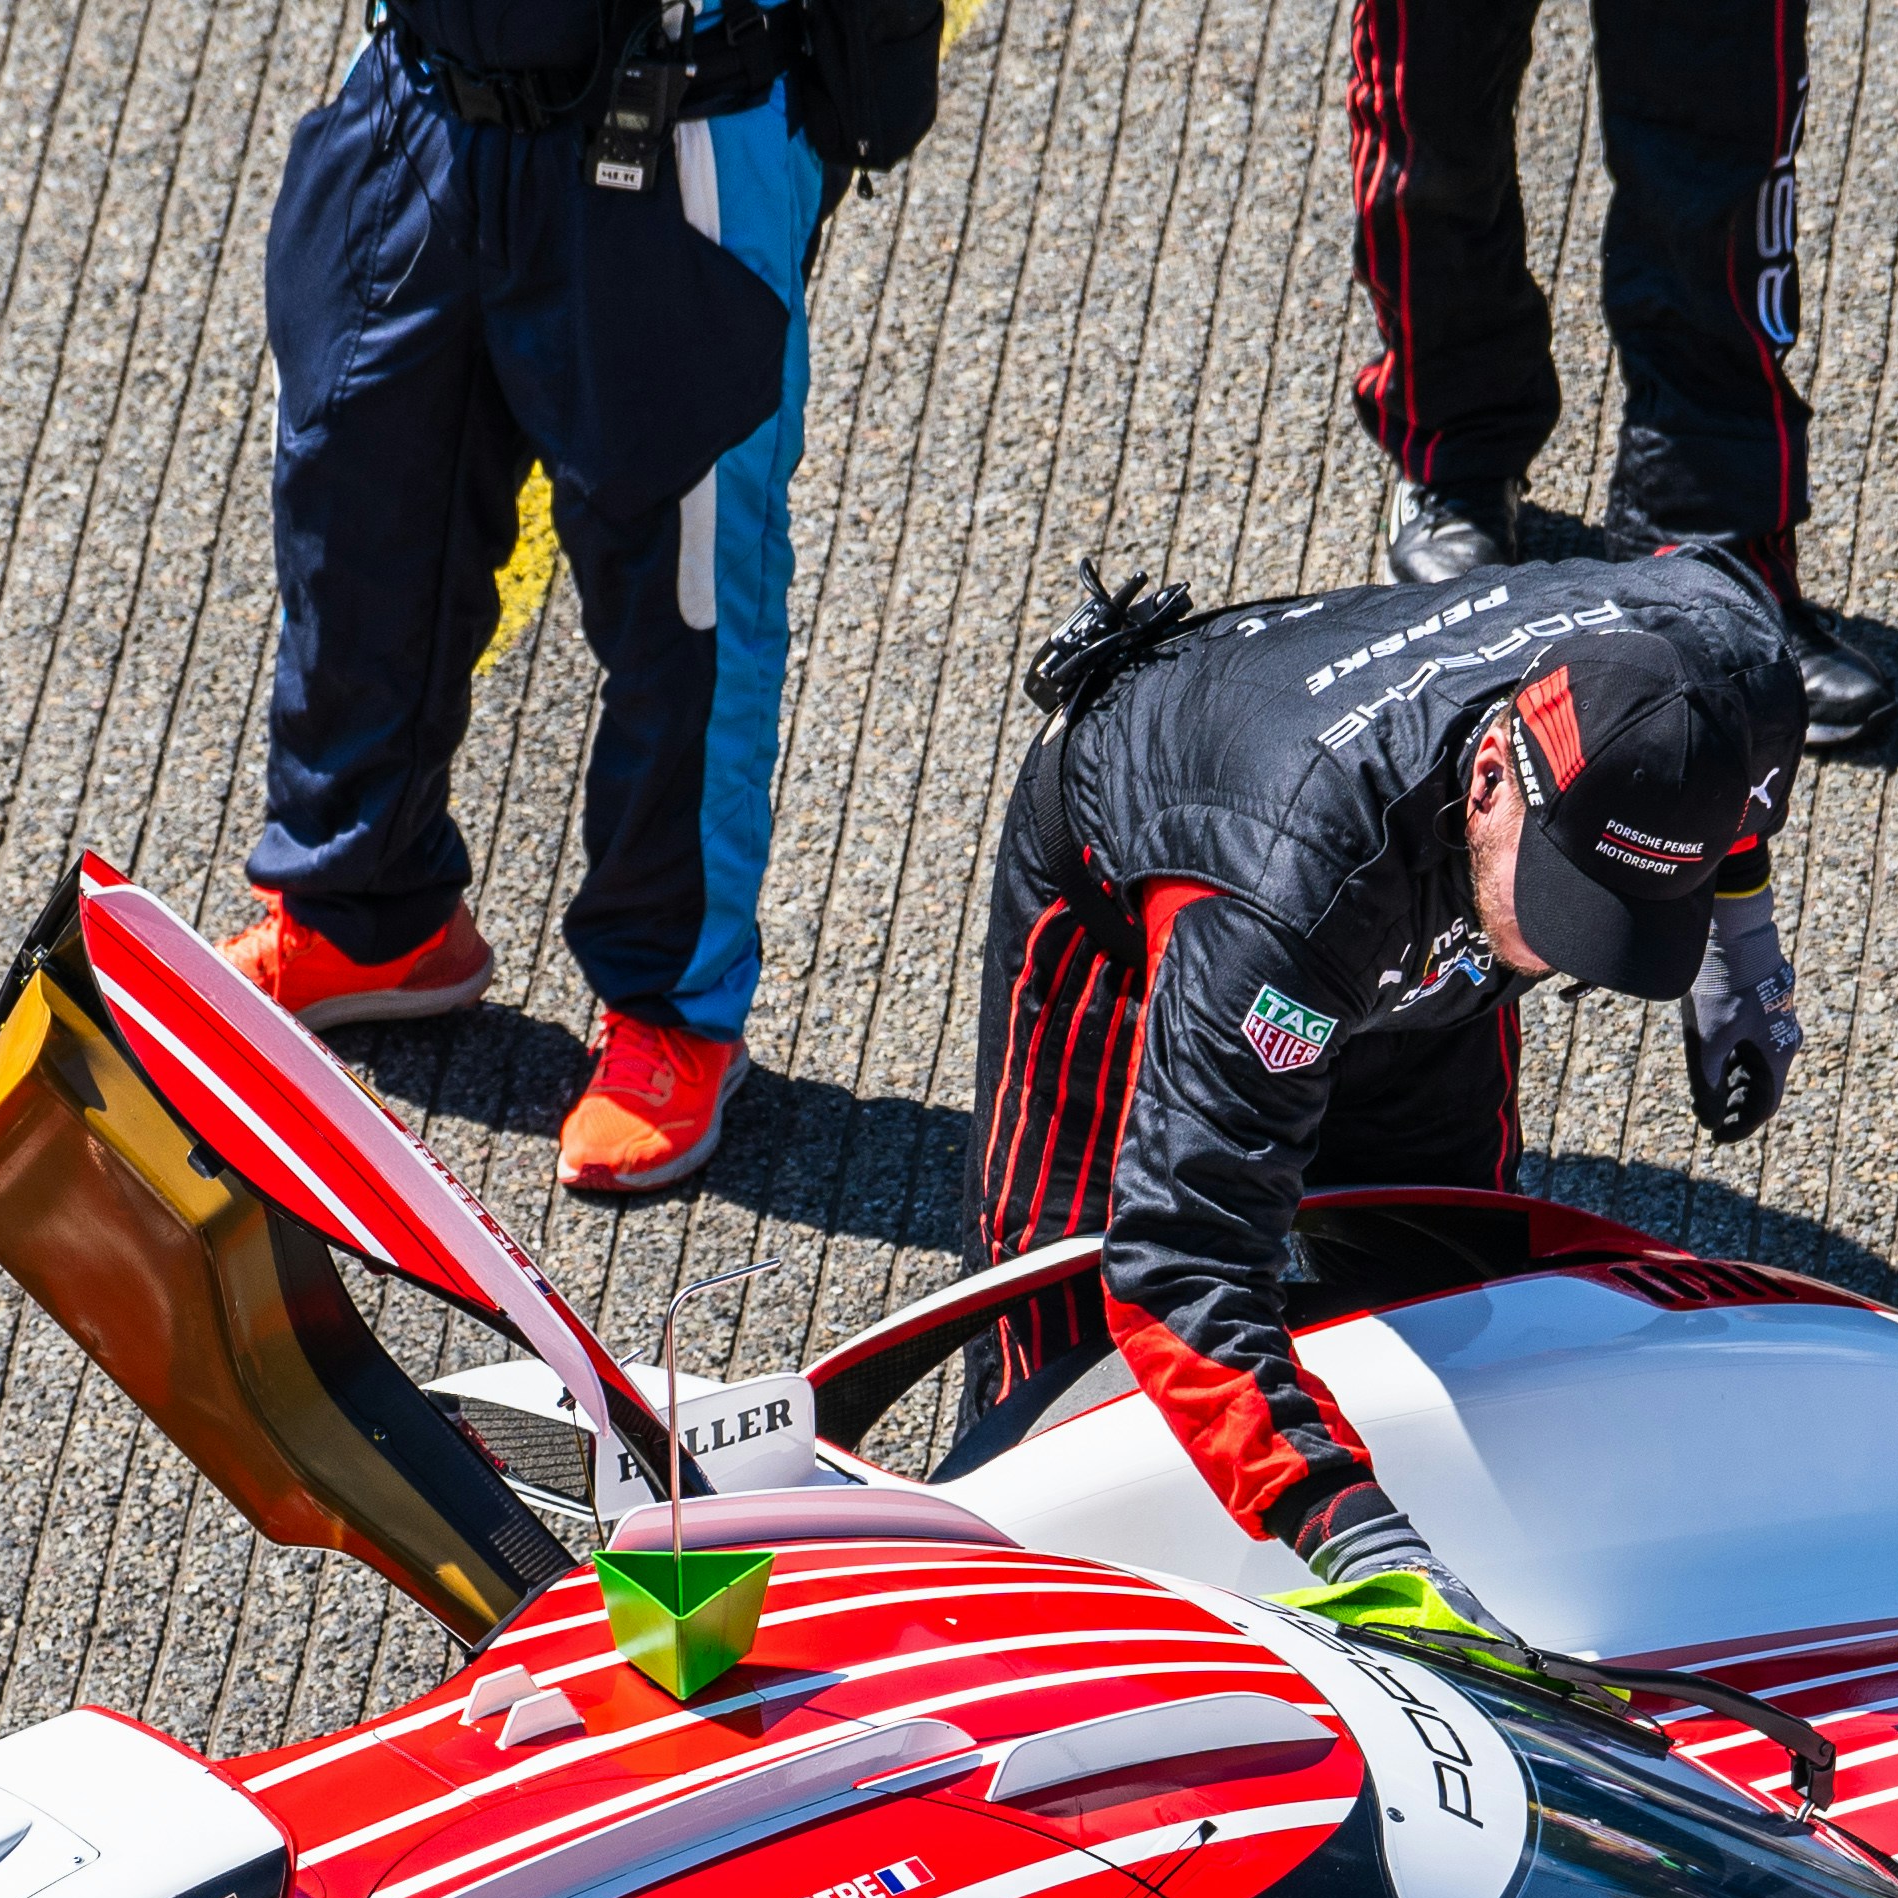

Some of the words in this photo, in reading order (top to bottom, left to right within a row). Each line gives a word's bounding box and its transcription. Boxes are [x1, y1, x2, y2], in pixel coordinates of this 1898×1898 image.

[1305, 585, 1510, 696] PENSKE
[1316, 599, 1625, 751] PORSCHE
[1511, 716, 1544, 808] PENSKE
[1595, 840, 1679, 876] MOTORSPORT
[1606, 819, 1662, 850] PORSCHE
[1663, 841, 1704, 855] PENSKE
[1246, 1015, 1322, 1068] HEUER
[1265, 992, 1330, 1040] TAG
[616, 1397, 793, 1484] HLLER
